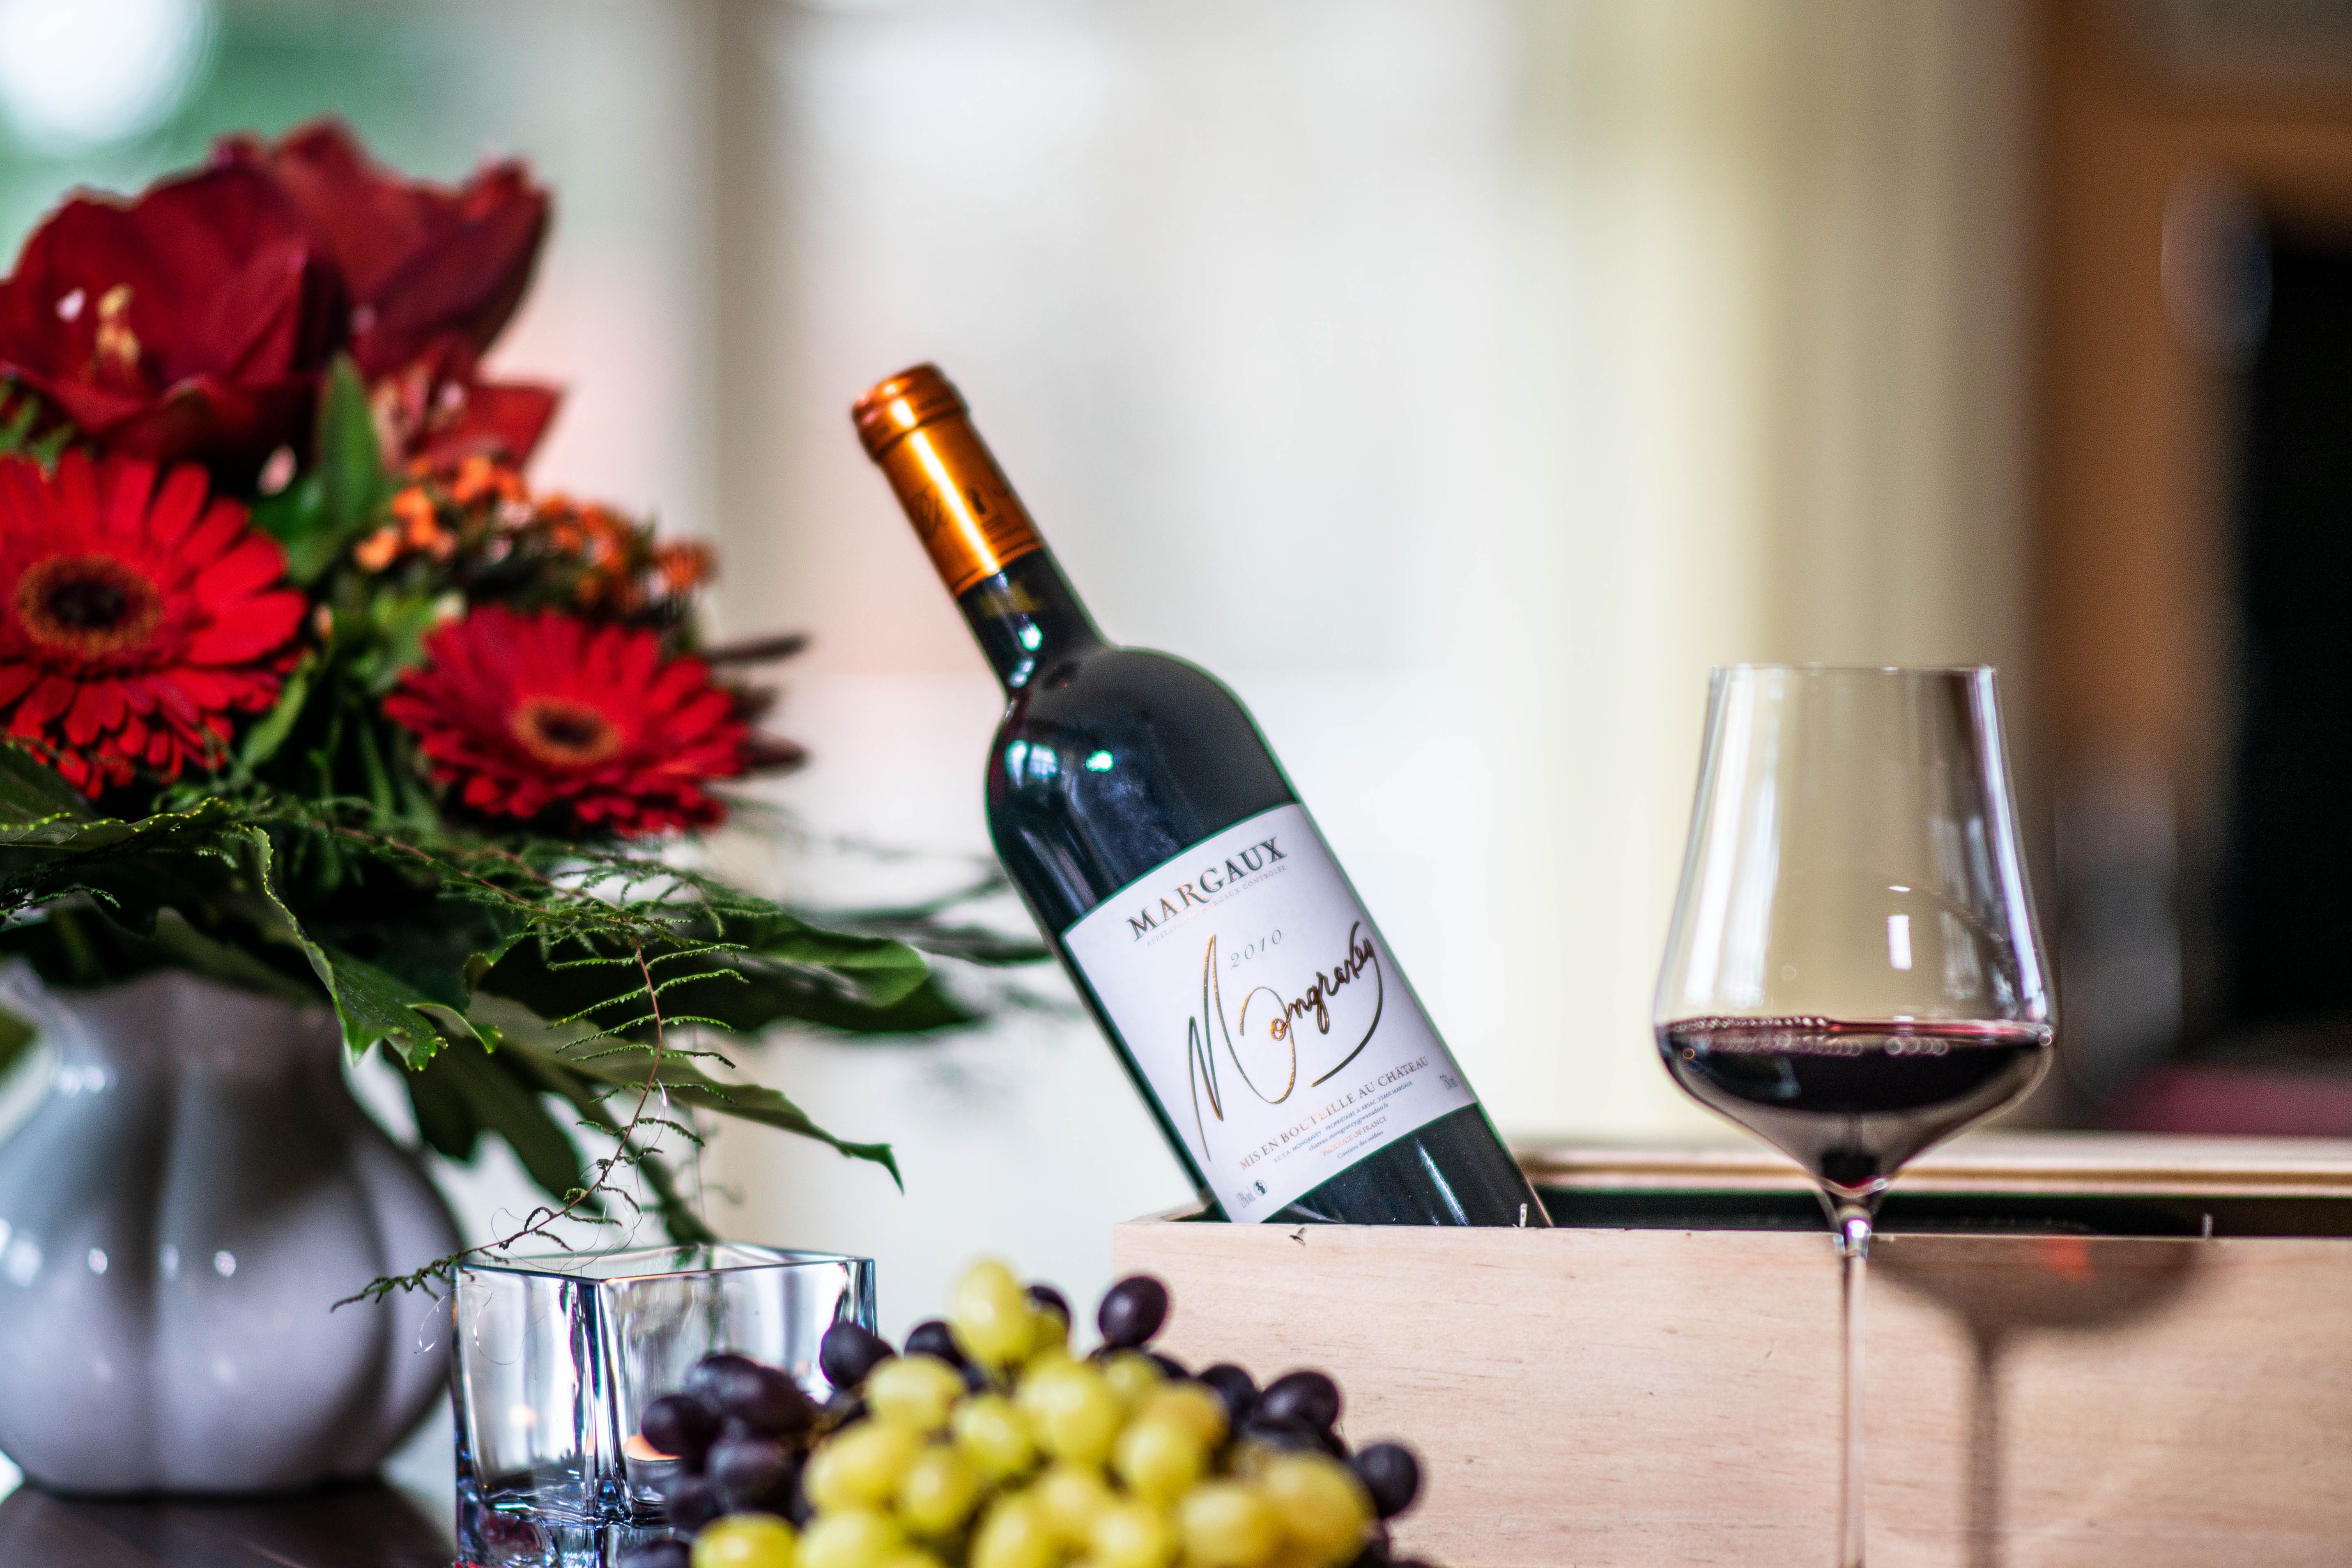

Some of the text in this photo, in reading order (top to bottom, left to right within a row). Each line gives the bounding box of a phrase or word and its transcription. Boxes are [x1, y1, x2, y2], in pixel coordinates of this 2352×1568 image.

[1126, 836, 1288, 943] MARGAUX
[1147, 912, 1199, 947] APPELLA
[1242, 864, 1287, 890] CONTRÔLÉE
[1231, 929, 1282, 969] 2010
[1239, 1056, 1429, 1170] MIS EN BOUTEILLE AU CHÂTEAU
[1292, 1130, 1322, 1152] MONGRAVEY
[1325, 1110, 1356, 1131] PROPRIÉTAIRE
[1362, 1100, 1377, 1111] ARSAC
[1377, 1092, 1392, 1102] 33460
[1392, 1081, 1413, 1094] MARGAUX
[1308, 1102, 1389, 1151] chateau.mongravey@wanadoo.fr
[1321, 1115, 1388, 1157] PRODUCE OF FRANCE
[1337, 1145, 1359, 1159] Contient
[1368, 1130, 1384, 1142] sulfites
